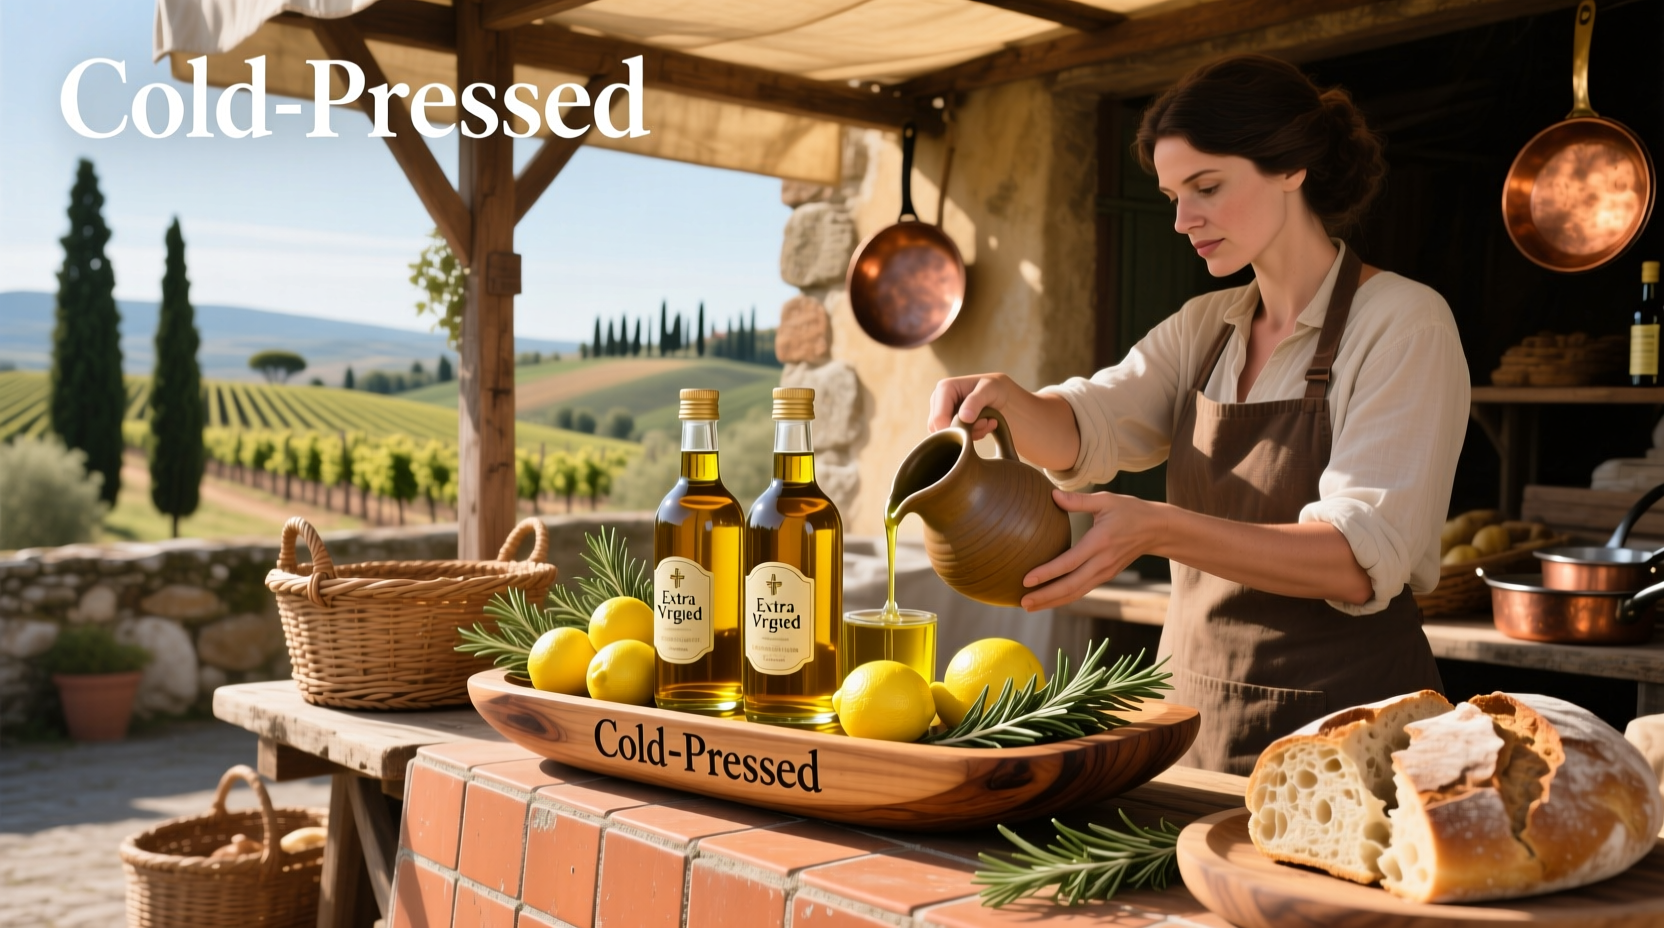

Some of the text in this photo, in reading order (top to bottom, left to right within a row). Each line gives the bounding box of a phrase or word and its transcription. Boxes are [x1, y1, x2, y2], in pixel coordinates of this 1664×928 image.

[662, 590, 696, 606] Extra
[756, 597, 795, 613] Extra
[594, 718, 823, 794] Cold-Pressed
